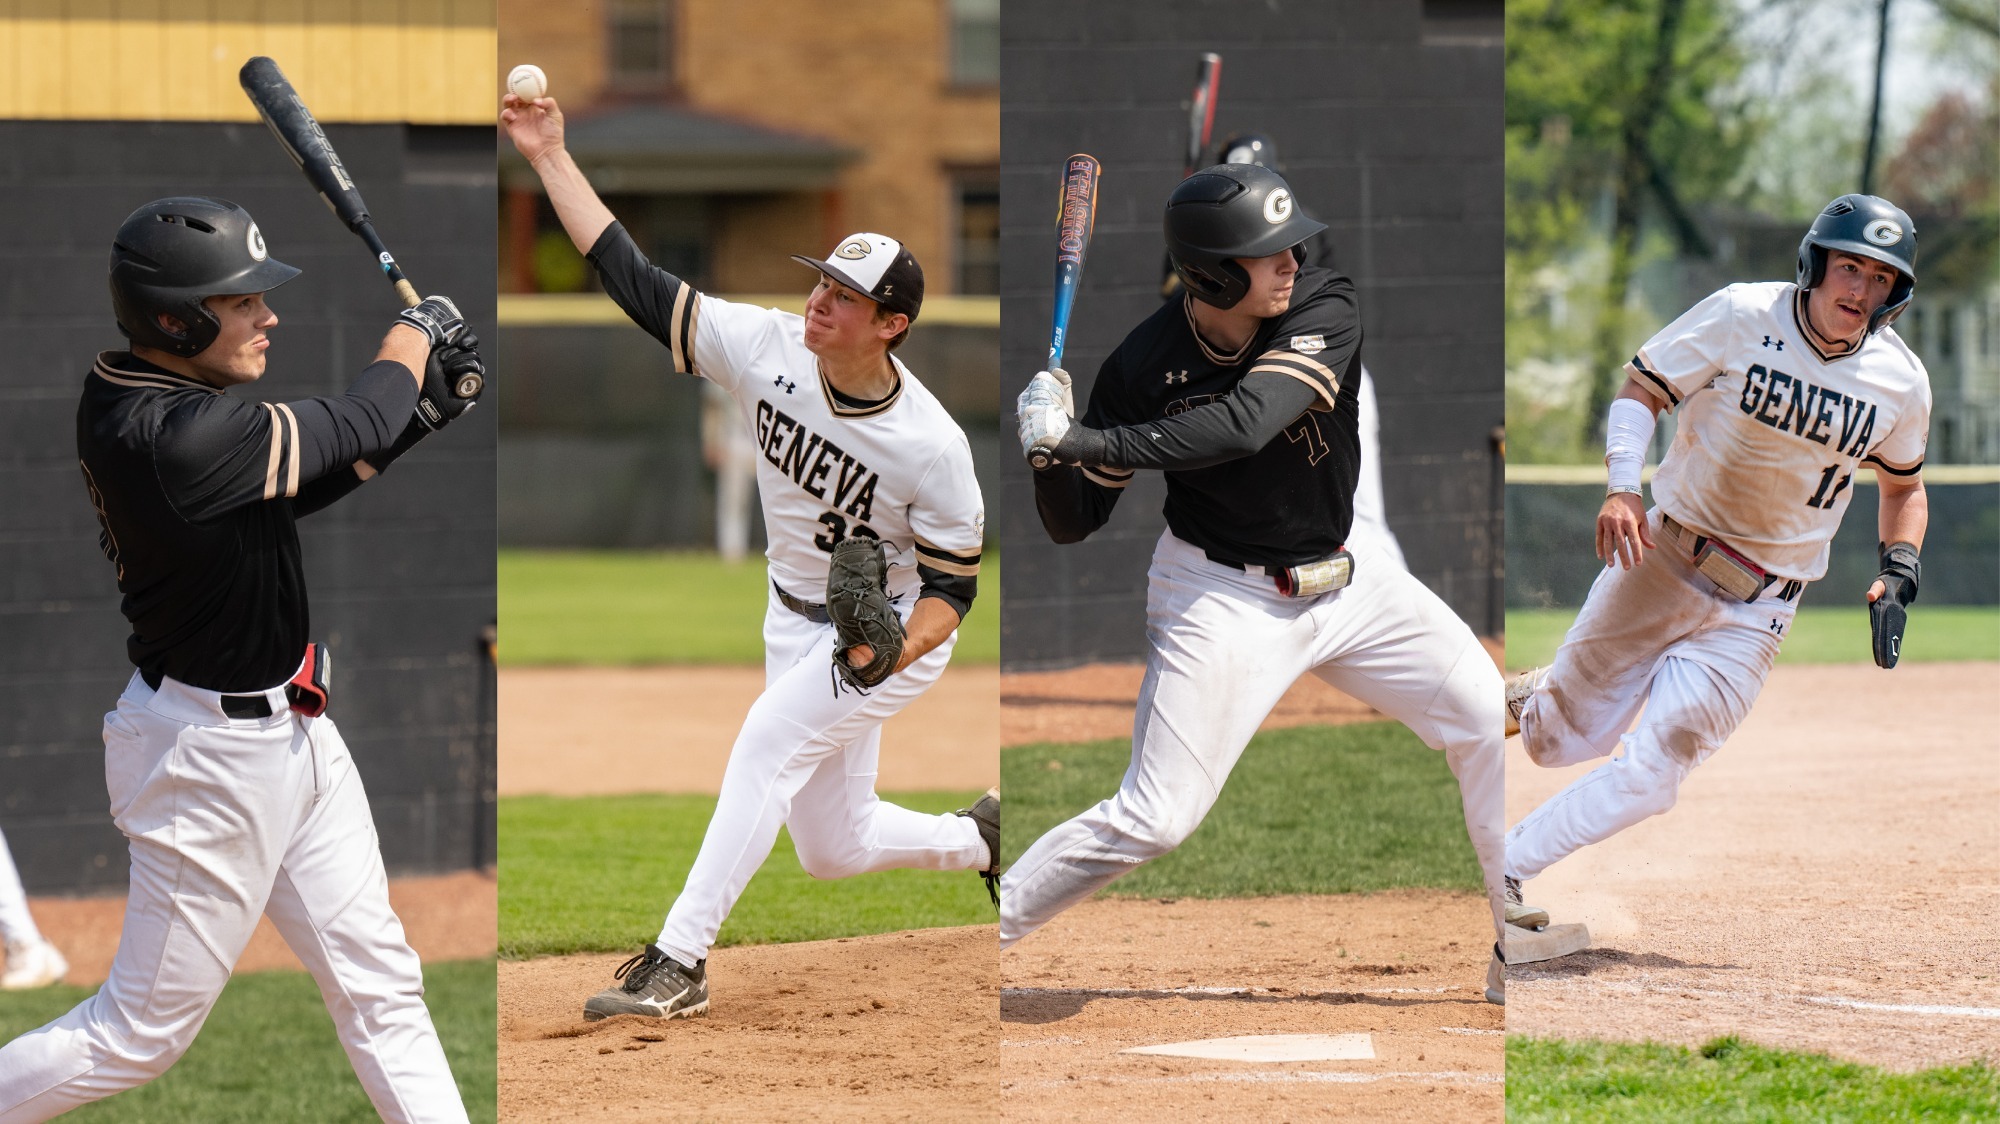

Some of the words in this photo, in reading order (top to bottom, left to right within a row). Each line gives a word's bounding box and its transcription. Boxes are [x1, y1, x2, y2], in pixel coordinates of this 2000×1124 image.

[1059, 160, 1092, 264] LOUISVILLE
[1264, 187, 1292, 224] G
[835, 238, 872, 260] G
[1863, 219, 1903, 246] G
[884, 285, 893, 296] Z
[1739, 363, 1877, 458] GENEVA
[756, 398, 880, 523] GENEVA
